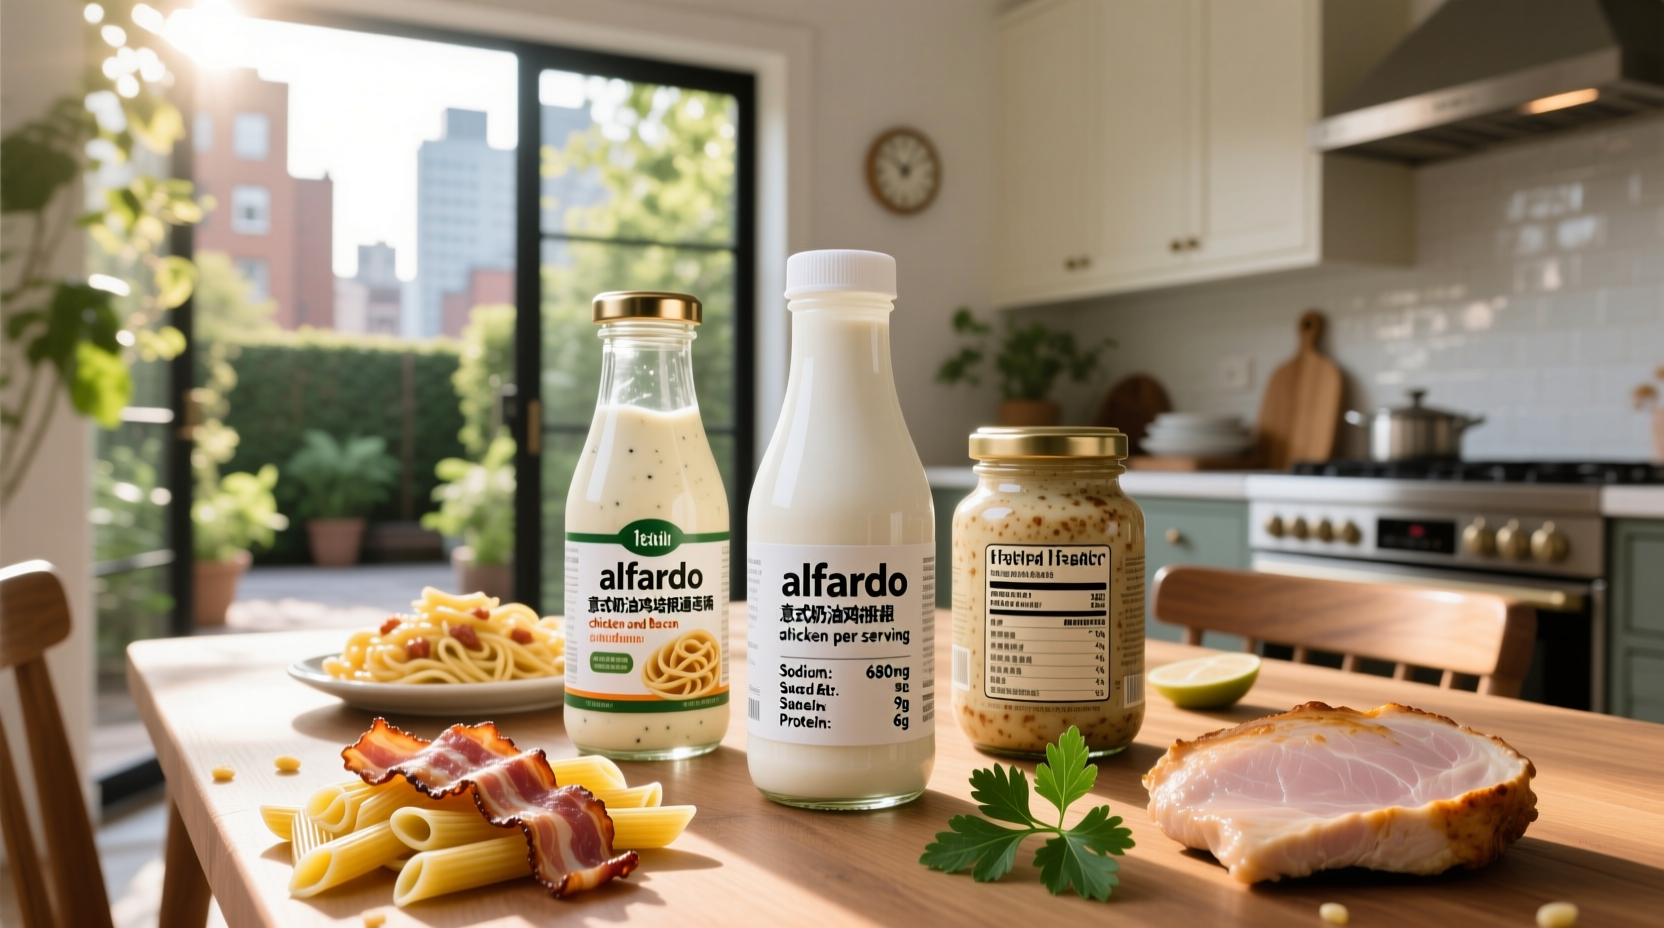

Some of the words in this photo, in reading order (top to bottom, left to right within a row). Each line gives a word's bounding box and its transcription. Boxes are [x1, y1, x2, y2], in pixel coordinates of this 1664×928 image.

[599, 562, 704, 591] alfardo
[781, 562, 908, 597] alfardo
[833, 632, 859, 647] per
[861, 627, 910, 645] serving
[894, 696, 910, 713] 9g
[893, 713, 910, 731] 6g
